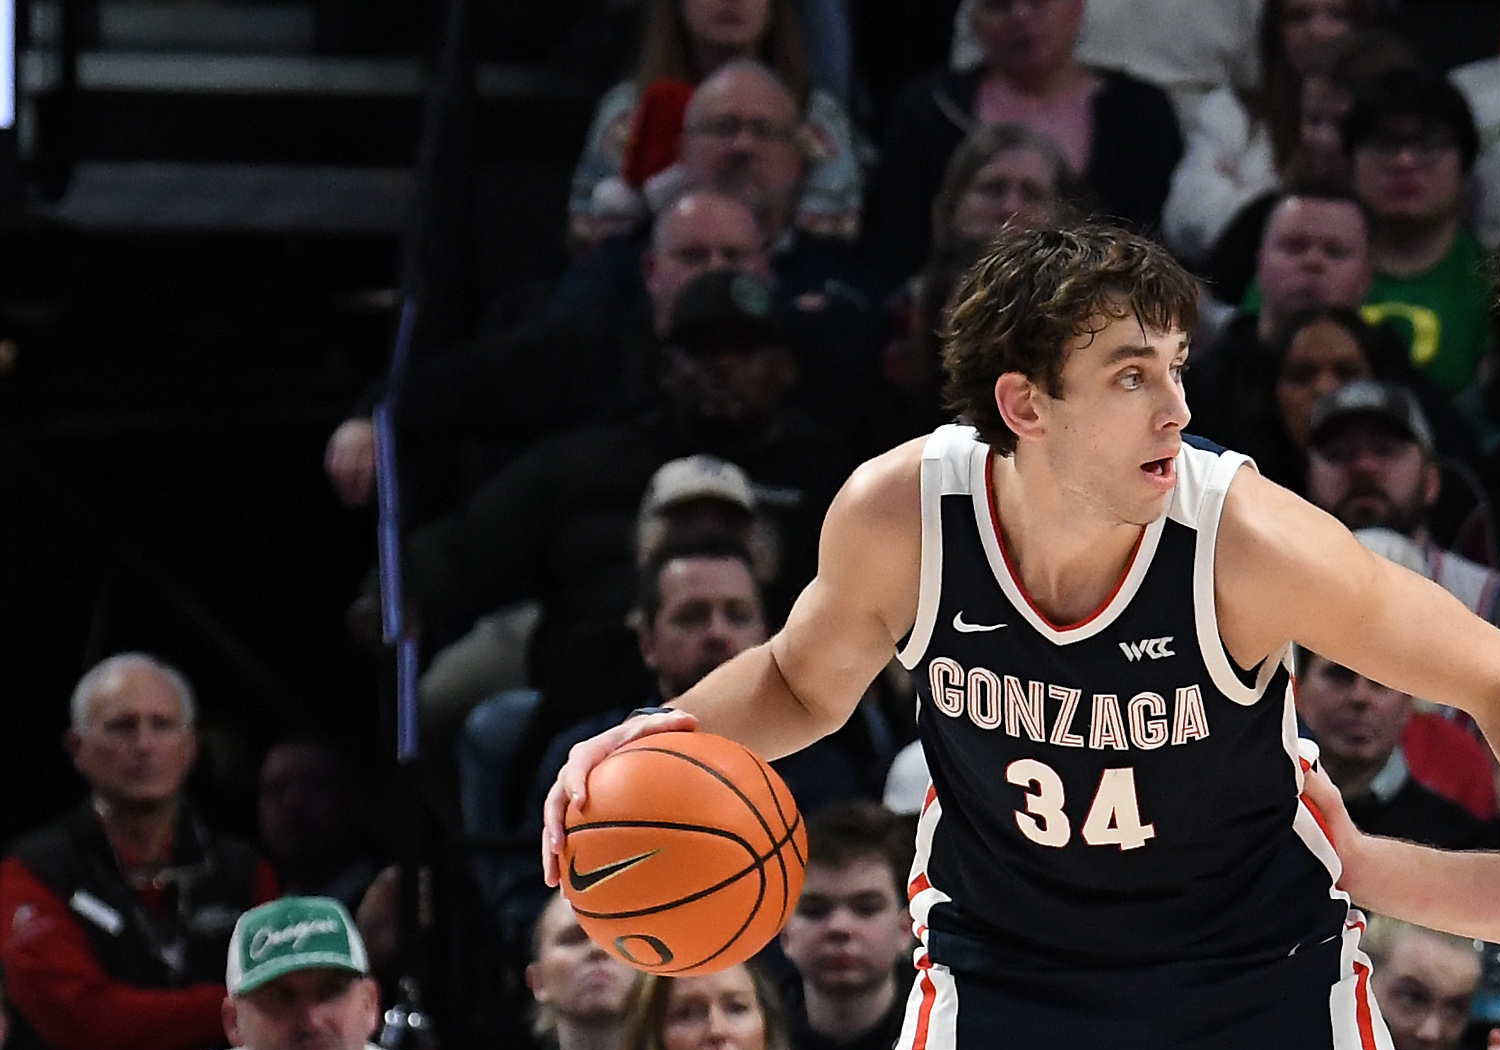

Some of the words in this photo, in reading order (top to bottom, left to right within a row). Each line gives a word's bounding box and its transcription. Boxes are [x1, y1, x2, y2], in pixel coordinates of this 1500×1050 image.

[1118, 636, 1176, 662] WCC
[928, 656, 1211, 751] GONZAGA
[1005, 758, 1157, 851] 34
